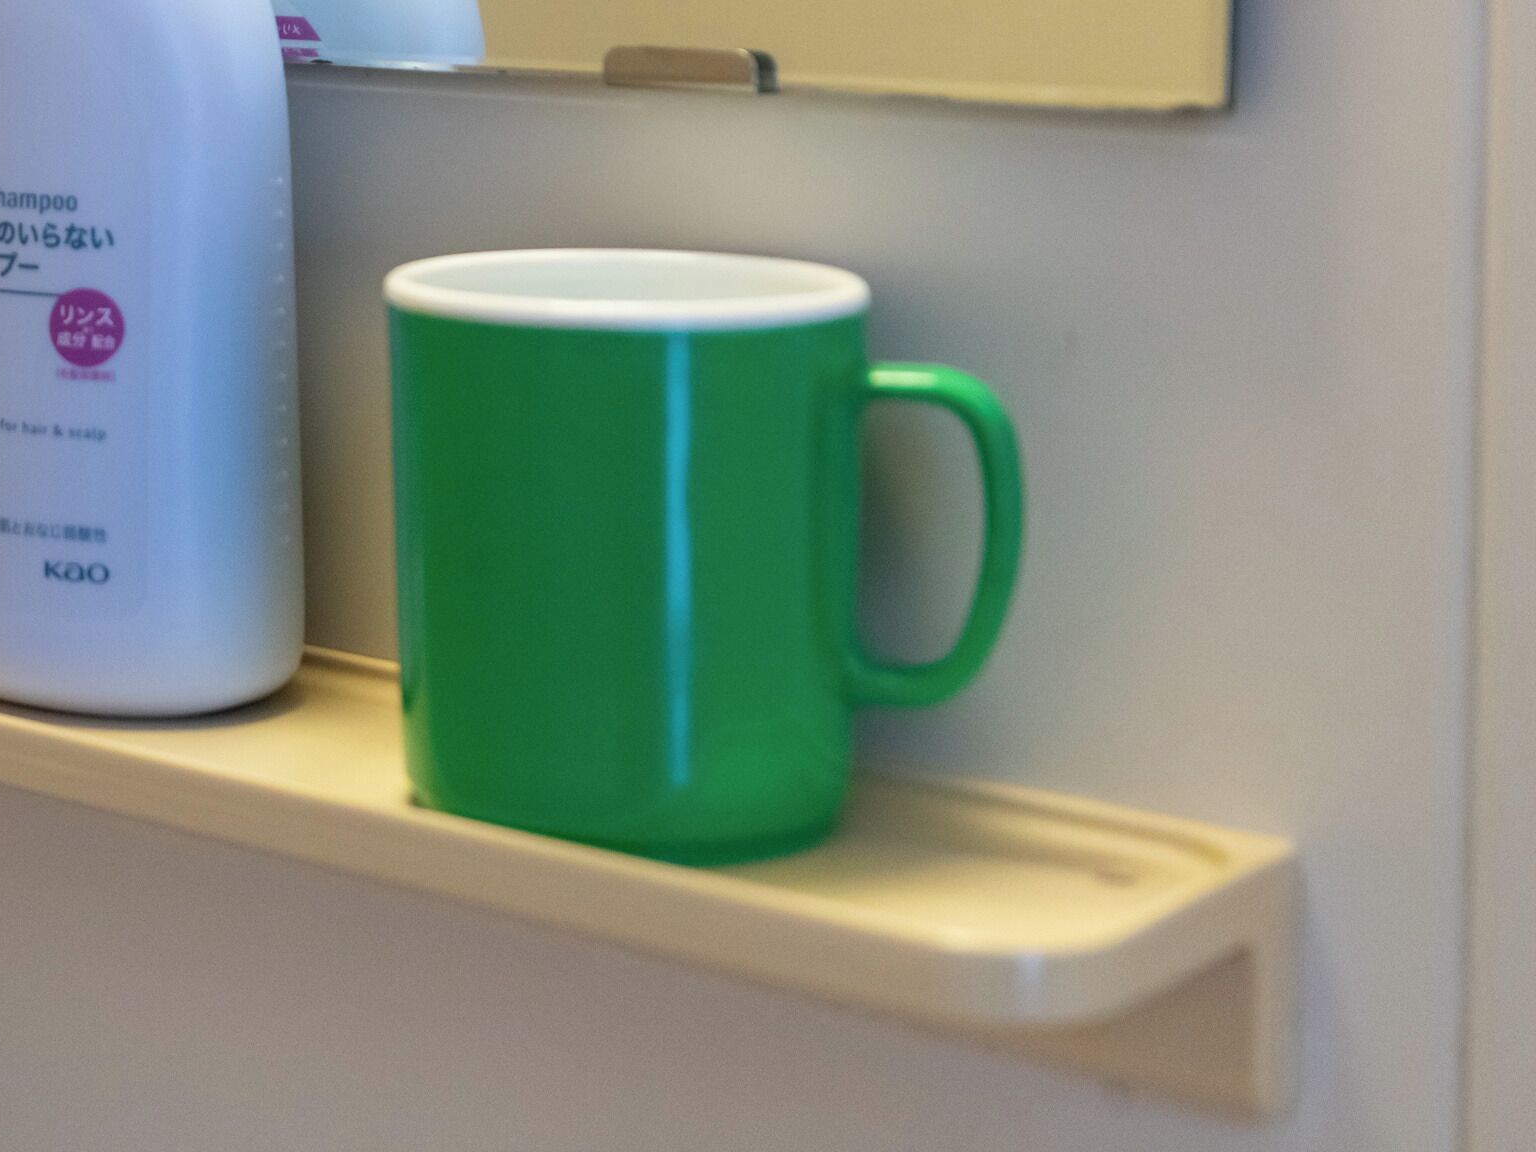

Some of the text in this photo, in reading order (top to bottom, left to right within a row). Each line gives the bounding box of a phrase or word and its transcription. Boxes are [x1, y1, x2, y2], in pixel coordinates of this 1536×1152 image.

[60, 303, 114, 326] リンス
[0, 417, 17, 431] for
[21, 420, 48, 435] hair
[52, 423, 63, 437] &
